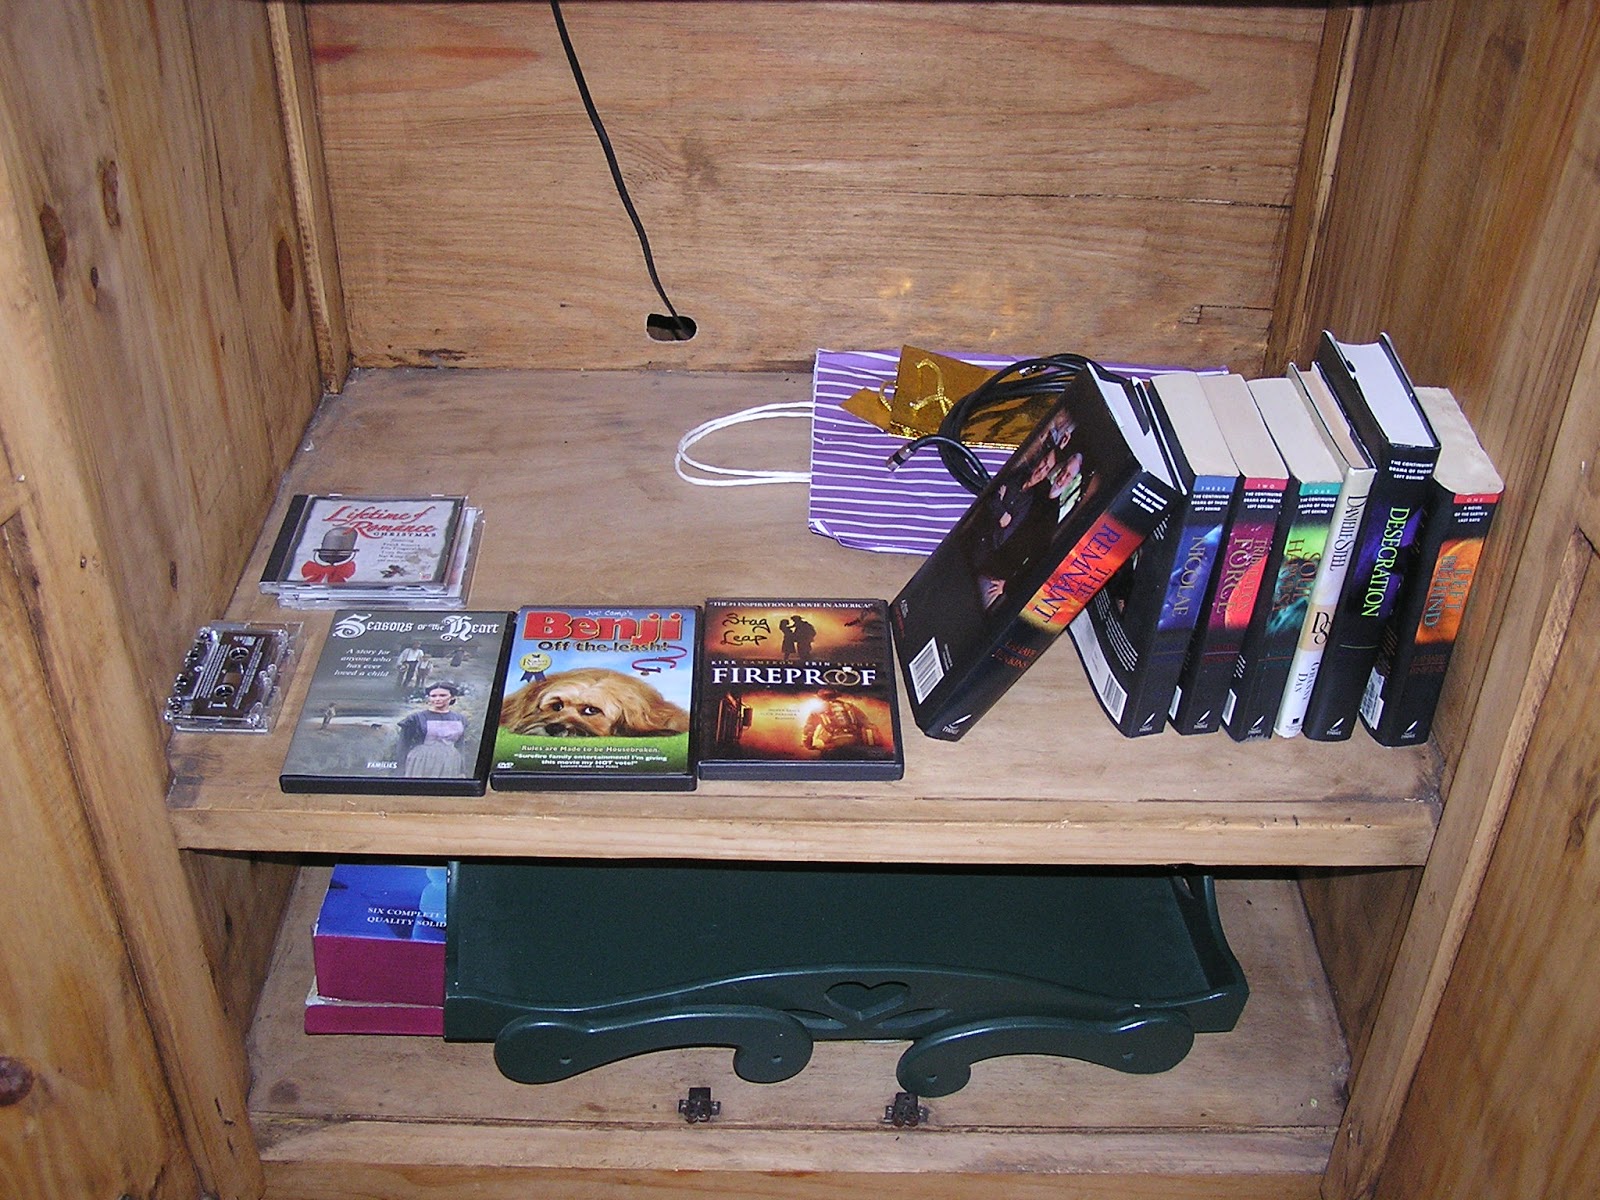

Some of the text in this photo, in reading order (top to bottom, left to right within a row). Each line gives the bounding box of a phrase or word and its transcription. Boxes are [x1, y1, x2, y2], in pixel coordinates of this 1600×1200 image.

[322, 506, 410, 526] Lifetime
[338, 520, 438, 539] Romance
[1032, 523, 1122, 624] REMNANT
[1171, 536, 1208, 617] NICOLAE
[1217, 537, 1254, 614] FORCE
[1291, 552, 1321, 602] SOUL
[1361, 506, 1411, 618] DESECRATION
[1424, 555, 1457, 627] BEHIND
[1445, 569, 1472, 613] LEFT
[332, 613, 414, 639] Seasons
[440, 615, 500, 642] Heart
[522, 611, 682, 646] Benji
[538, 641, 669, 652] Off the leash!
[712, 666, 876, 686] FIREPROOF
[366, 916, 447, 928] QUALITY SOLID
[367, 907, 386, 915] SIX
